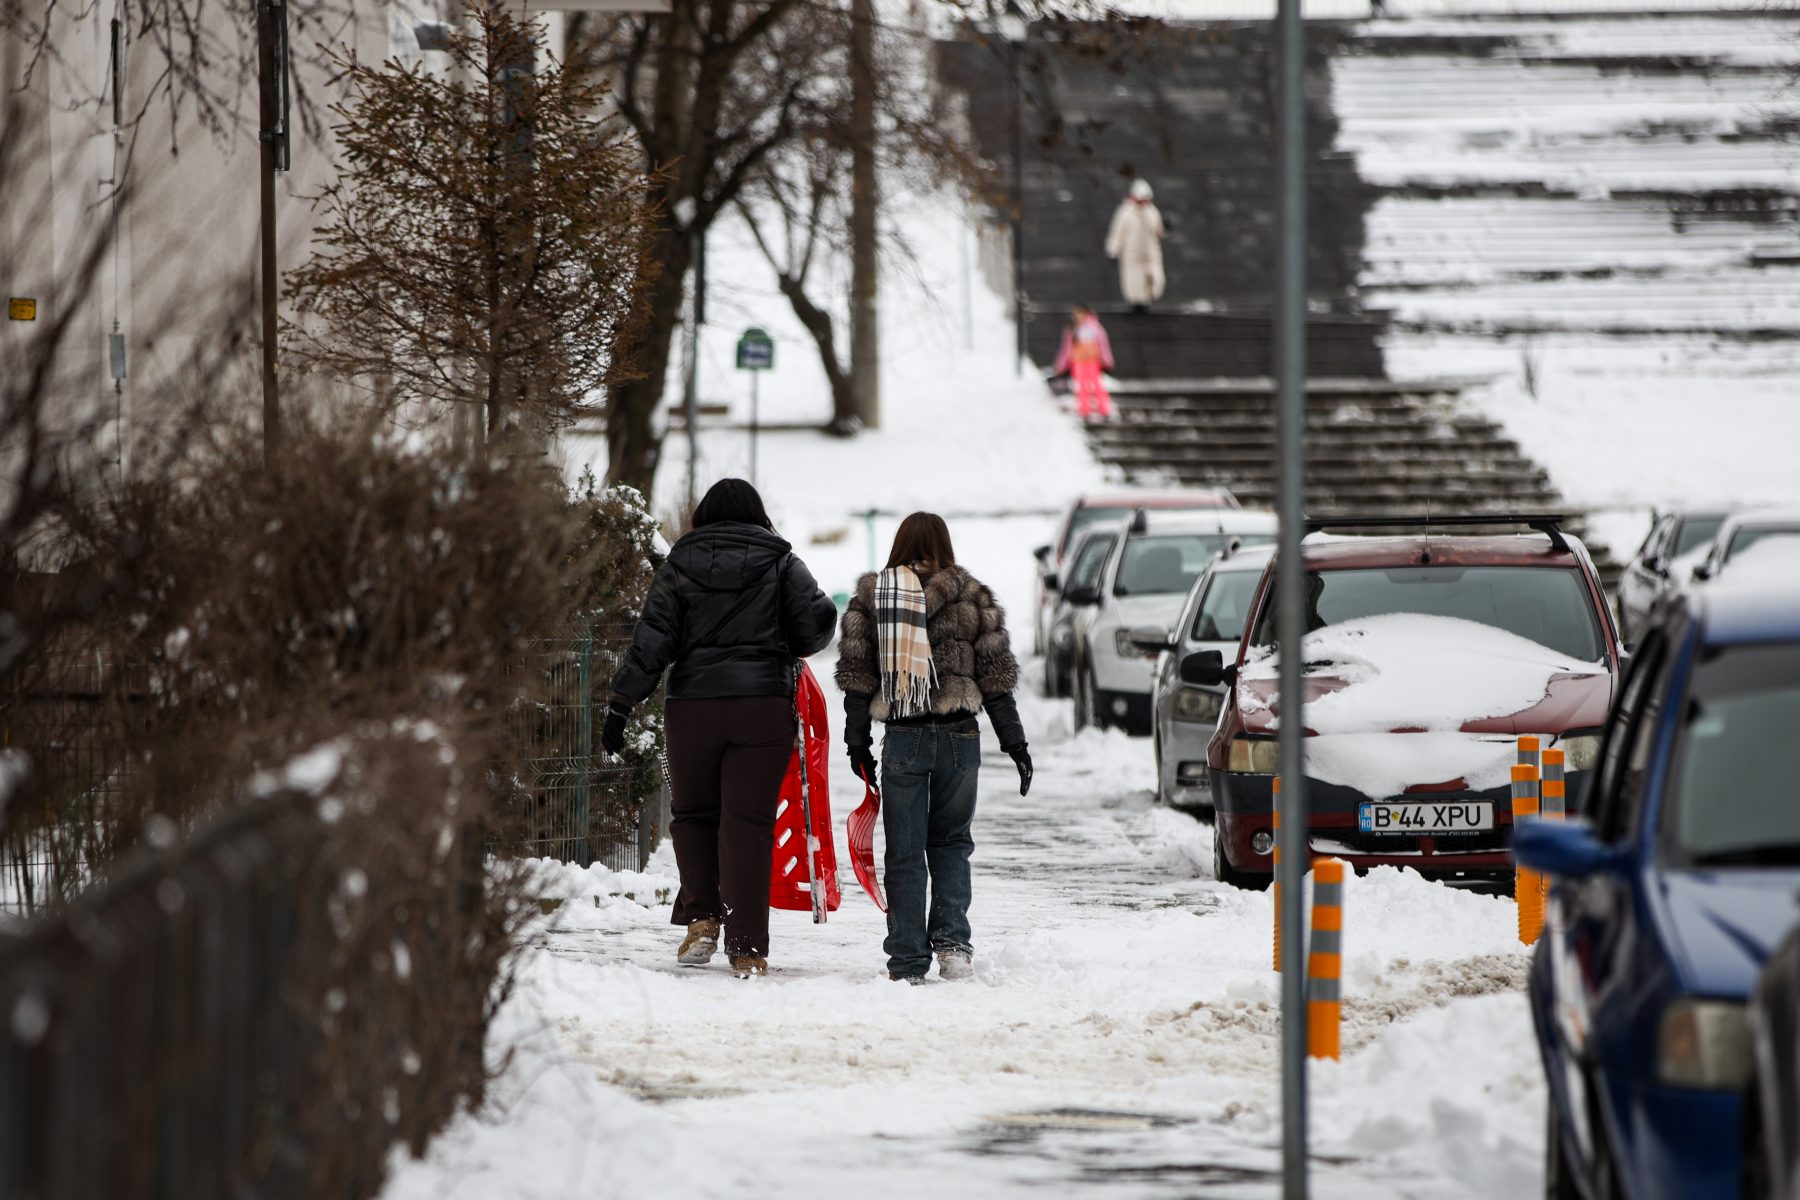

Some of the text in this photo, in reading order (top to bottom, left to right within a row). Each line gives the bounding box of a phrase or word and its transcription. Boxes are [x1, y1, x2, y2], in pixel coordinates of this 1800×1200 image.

[1361, 819, 1371, 828] RO
[1375, 806, 1480, 827] B 44 XPU
